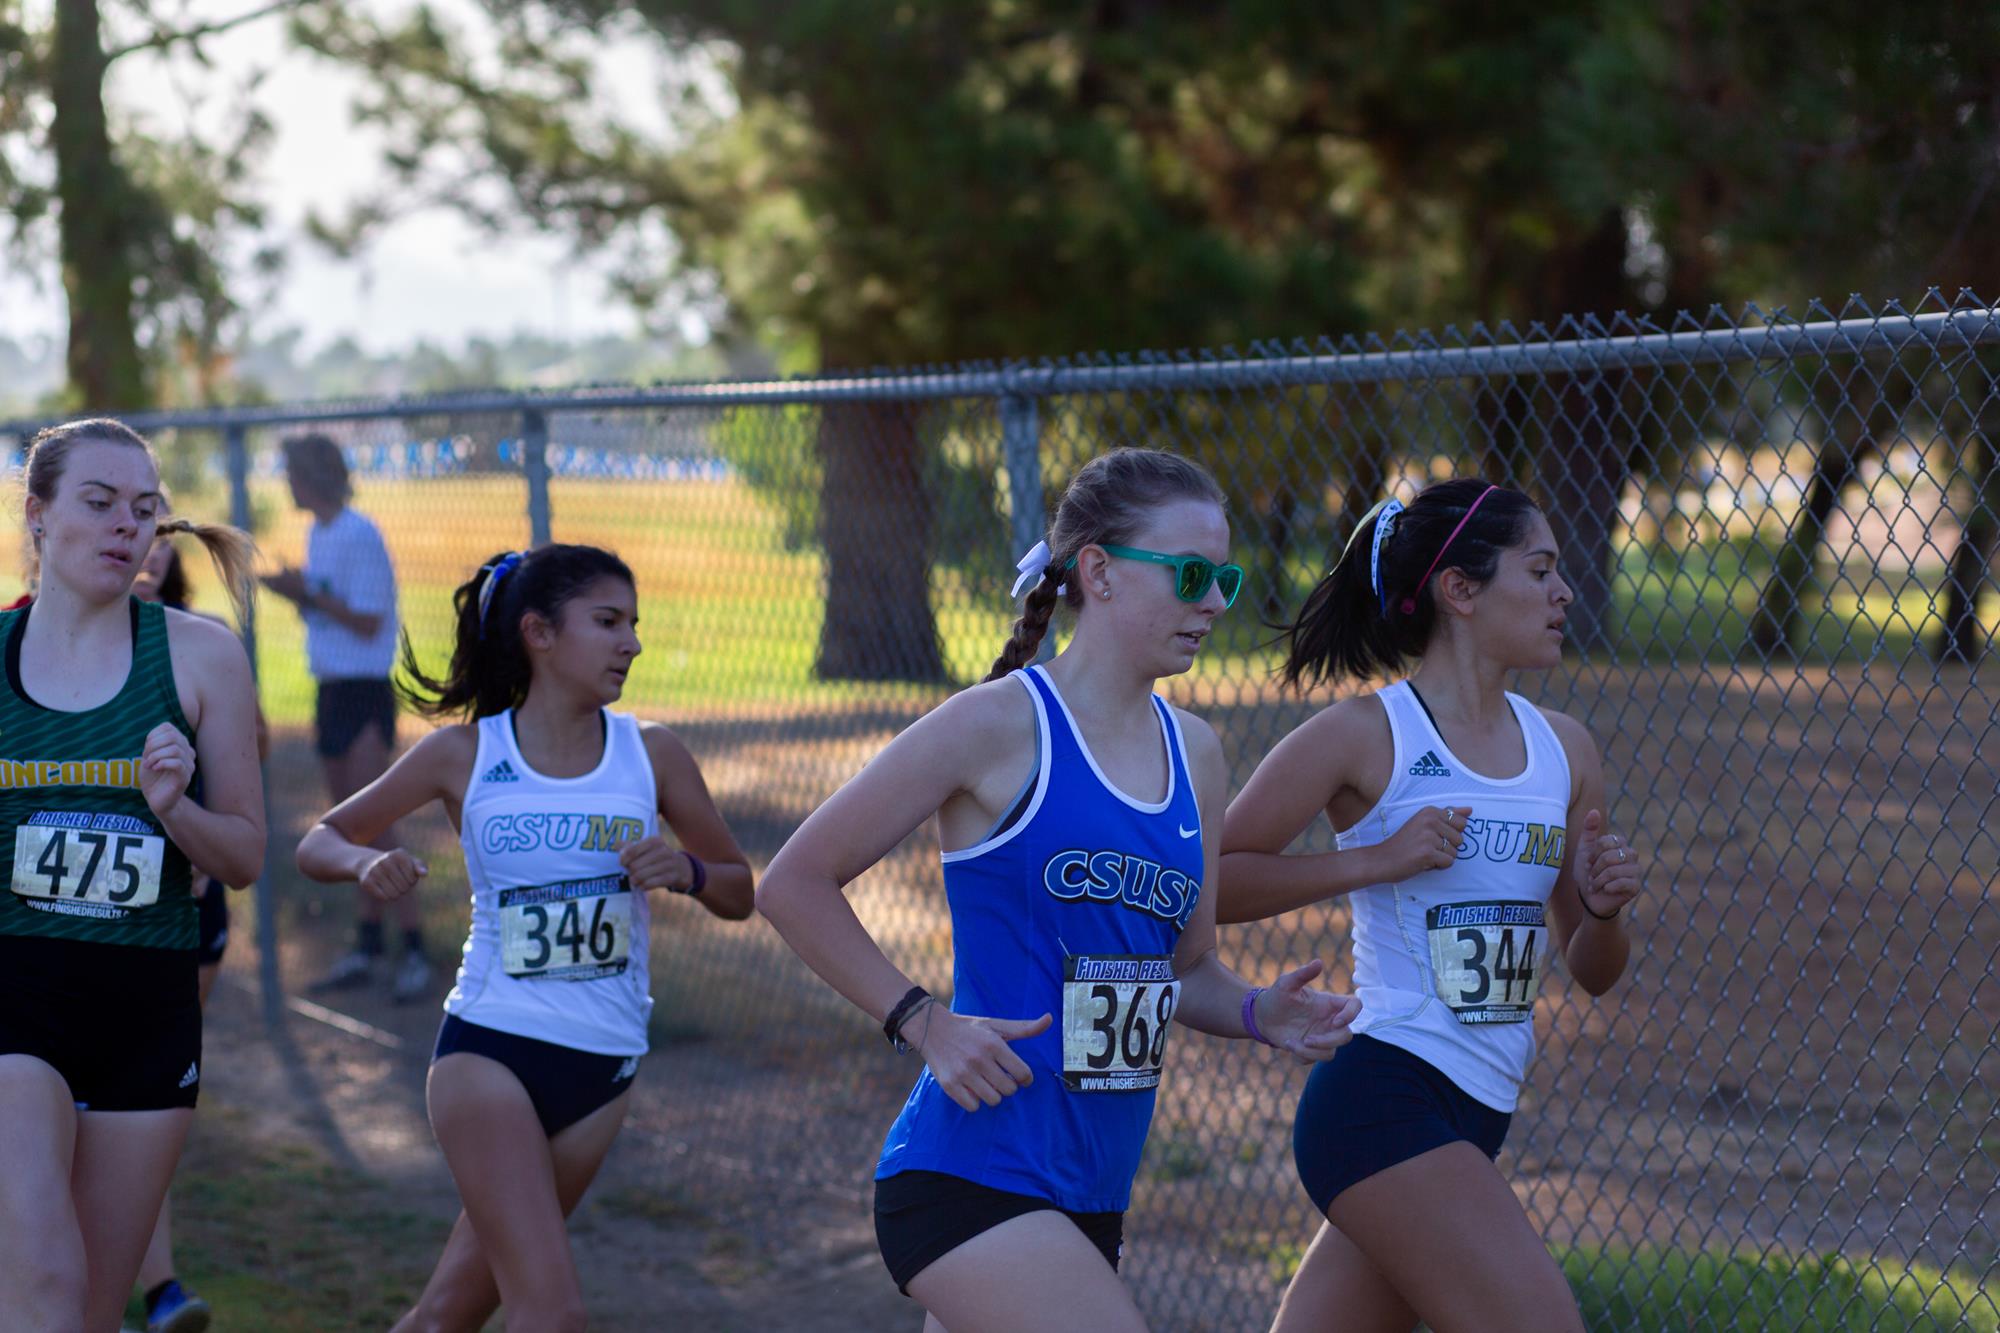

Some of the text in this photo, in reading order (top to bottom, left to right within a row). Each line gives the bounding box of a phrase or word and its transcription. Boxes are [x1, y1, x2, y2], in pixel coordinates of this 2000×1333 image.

[0, 757, 143, 789] ONCORDI
[1408, 766, 1451, 777] adidas
[27, 810, 93, 828] FINISHED
[1456, 818, 1566, 868] SUM
[36, 830, 144, 903] 475
[523, 898, 614, 969] 346
[1437, 905, 1501, 927] FINISHED
[1075, 956, 1139, 980] FINISHED
[1456, 929, 1536, 1004] 344
[1086, 984, 1174, 1070] 368
